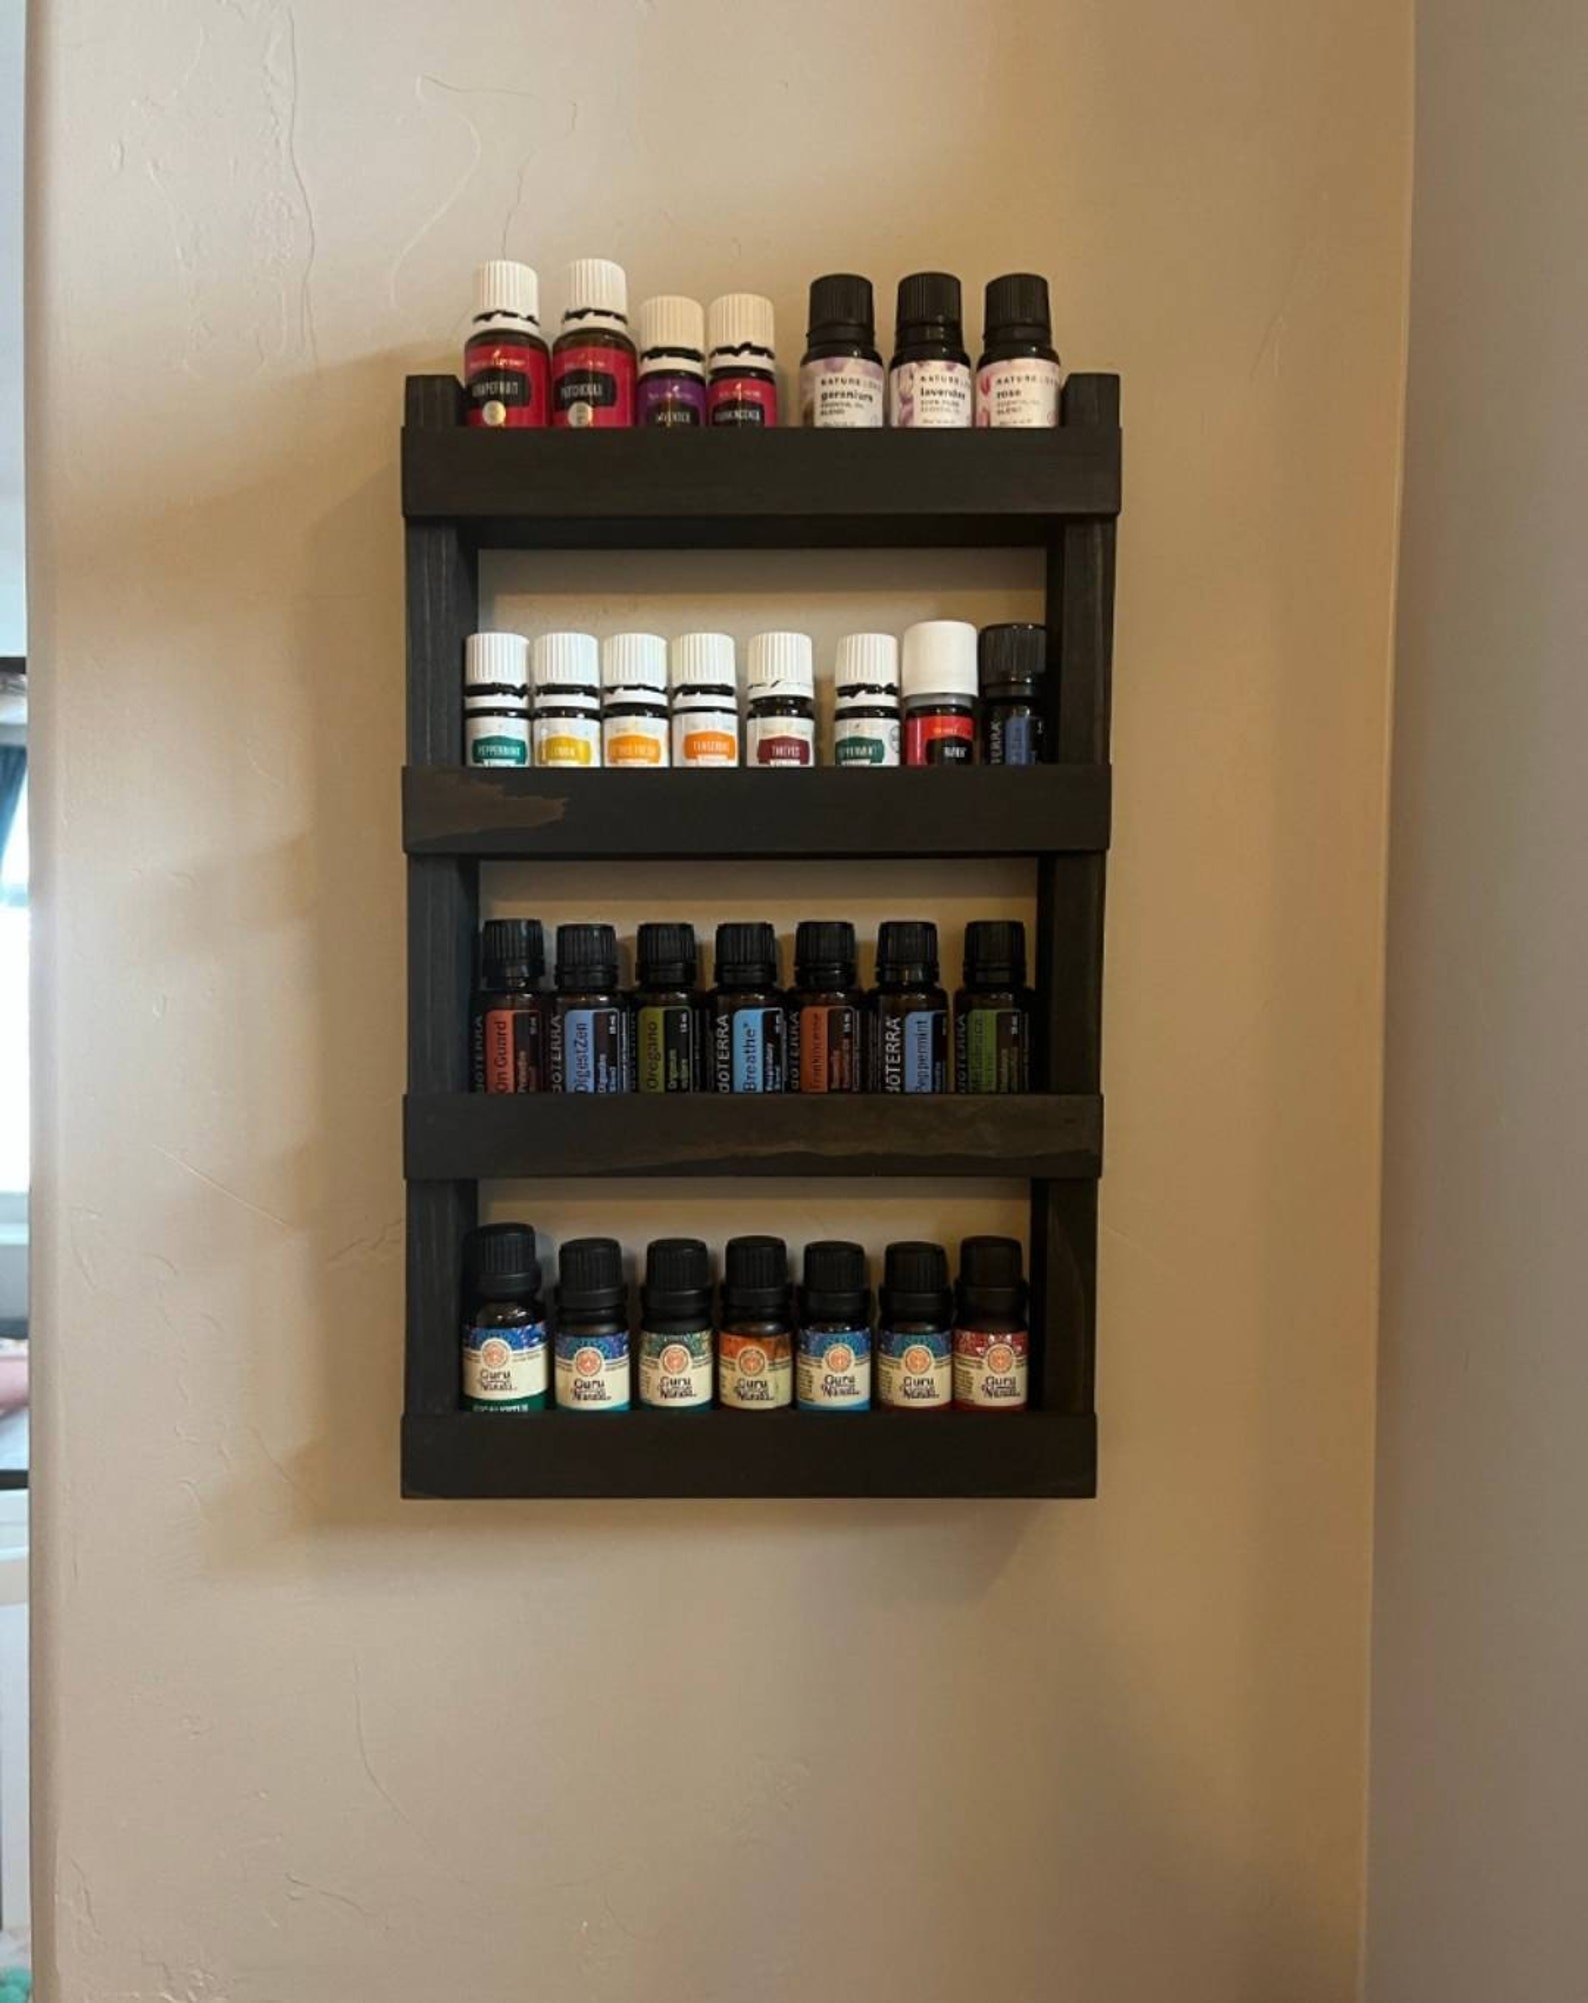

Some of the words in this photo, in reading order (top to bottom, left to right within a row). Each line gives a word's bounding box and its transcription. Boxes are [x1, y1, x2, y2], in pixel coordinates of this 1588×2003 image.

[821, 388, 873, 403] geranium
[920, 387, 966, 400] lavender
[996, 390, 1022, 400] rose
[493, 1021, 507, 1068] Guard
[645, 1021, 661, 1089] Oregano
[741, 1027, 757, 1092] Breathe
[494, 1072, 508, 1092] On
[480, 1369, 511, 1379] Guru
[824, 1374, 856, 1384] Guru
[574, 1379, 605, 1389] Guru
[660, 1376, 692, 1386] Guru
[737, 1378, 768, 1388] Guru
[903, 1376, 935, 1386] Guru
[986, 1376, 1017, 1386] Guru
